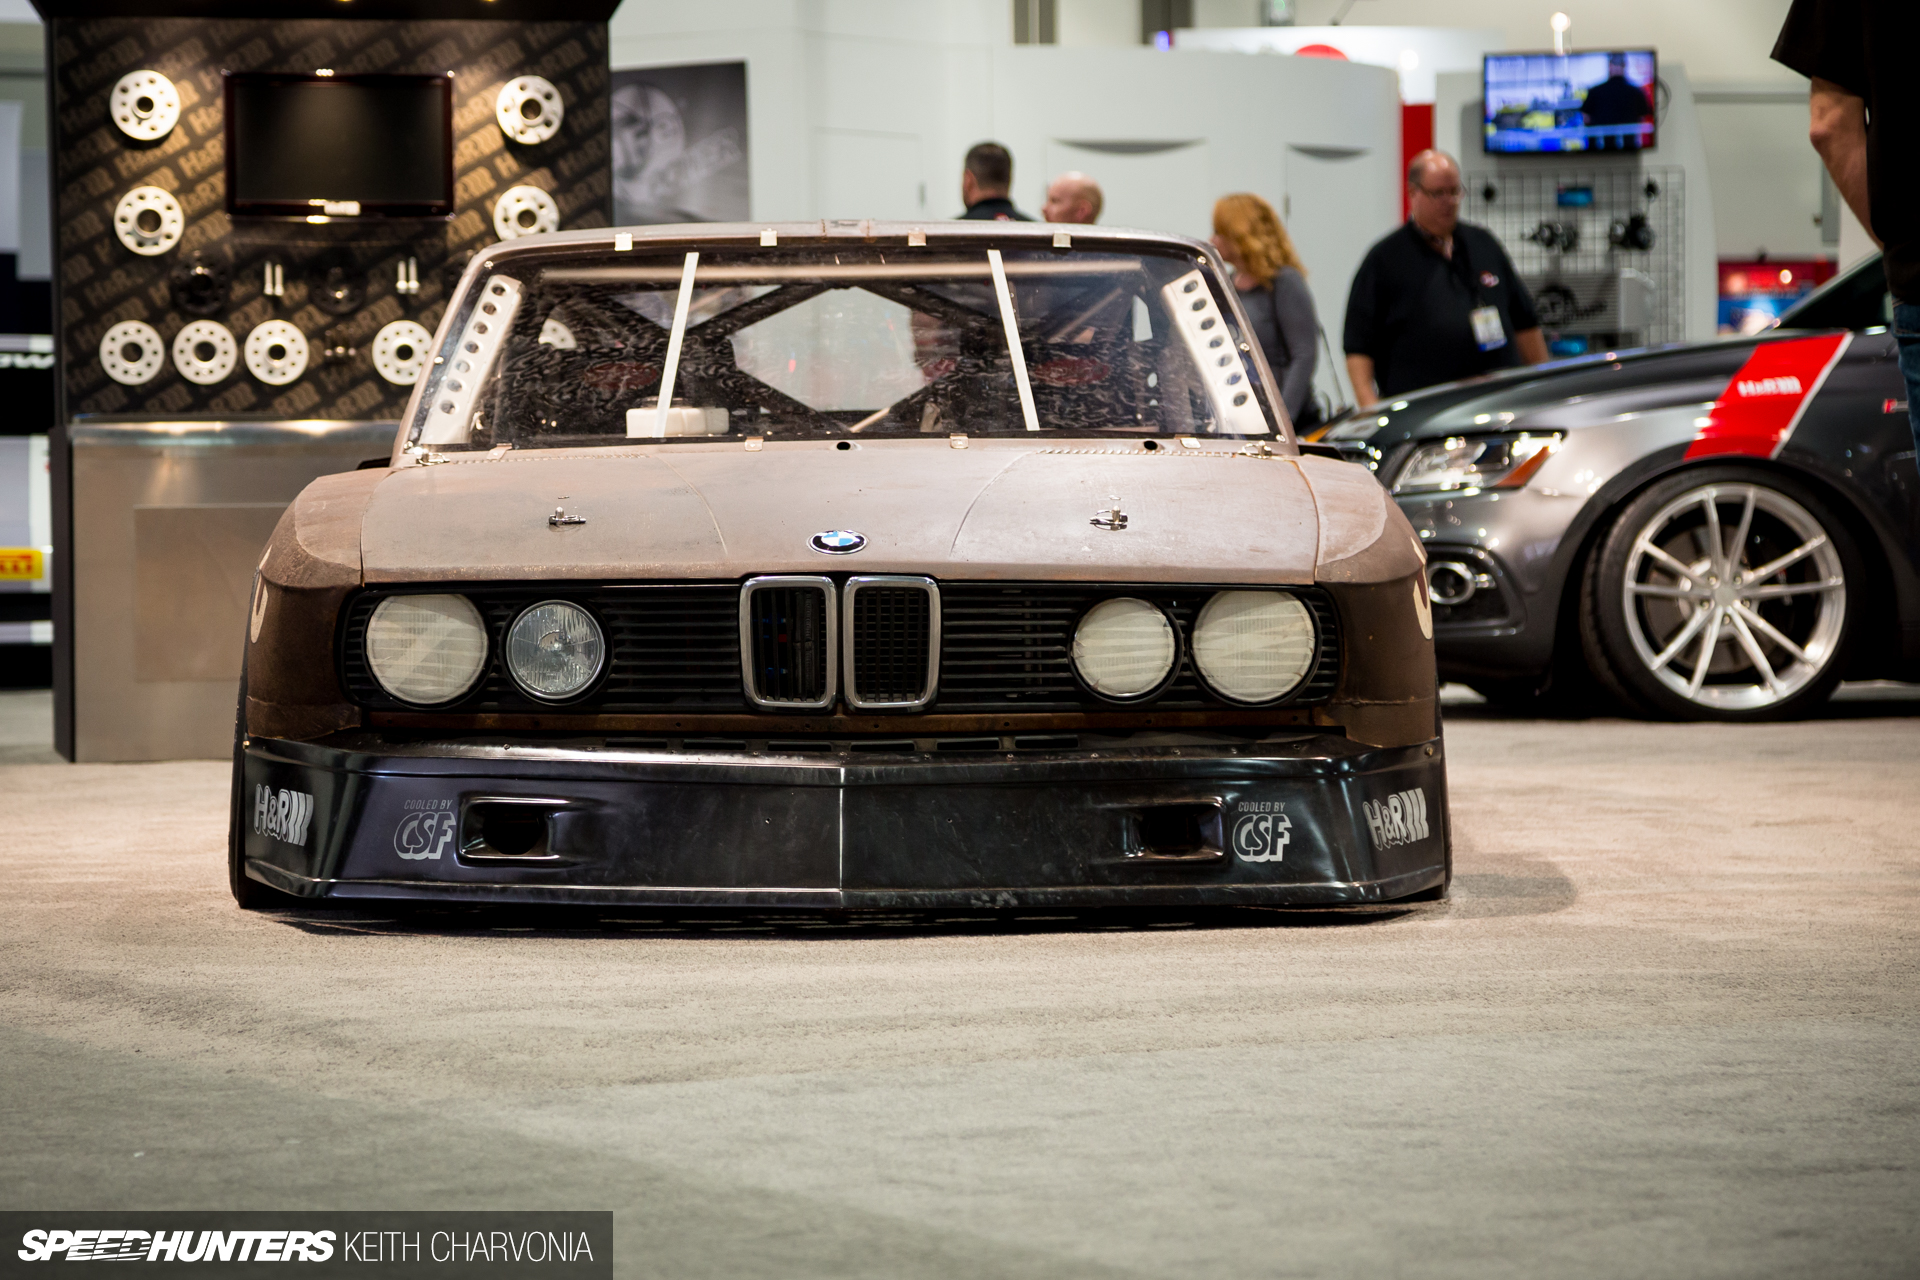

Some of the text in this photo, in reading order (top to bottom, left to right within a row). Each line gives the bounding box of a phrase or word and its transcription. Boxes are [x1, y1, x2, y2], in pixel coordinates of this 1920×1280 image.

[254, 783, 293, 842] H&R
[404, 799, 453, 810] COOLED BY
[1238, 801, 1285, 812] COOLED BY
[1363, 794, 1410, 850] H&R
[394, 811, 457, 860] CSF
[1233, 813, 1292, 863] CSF
